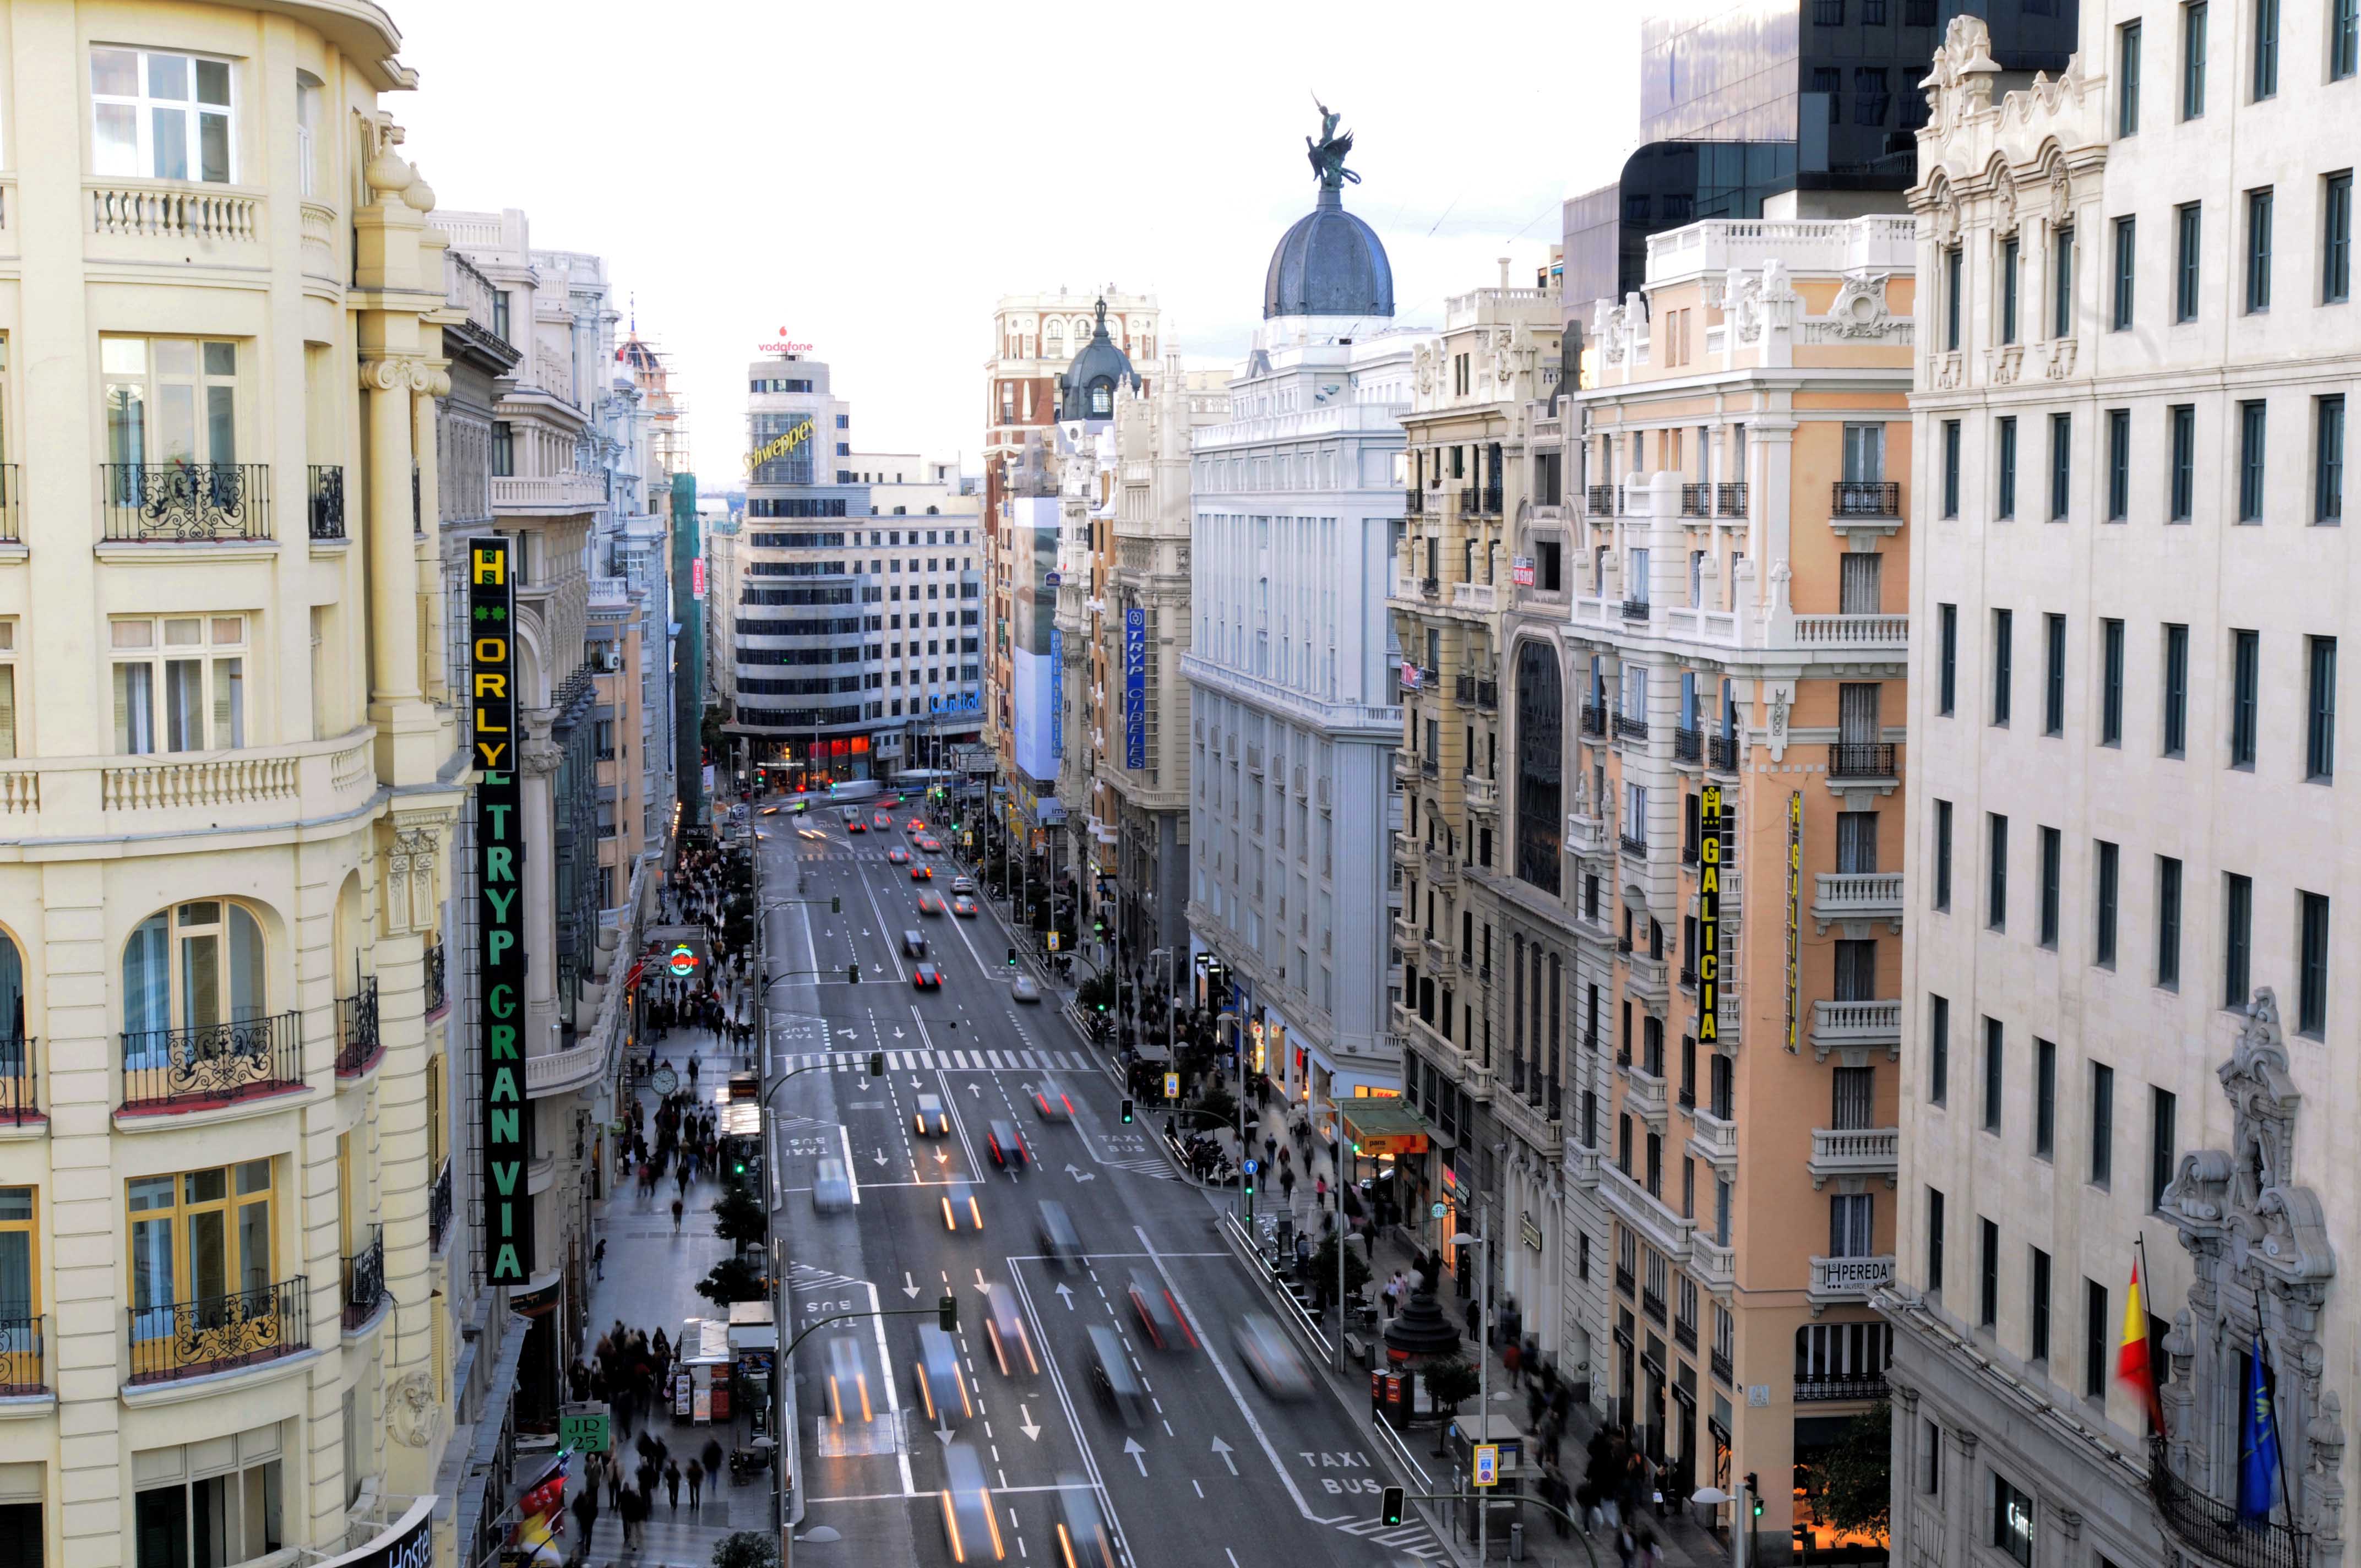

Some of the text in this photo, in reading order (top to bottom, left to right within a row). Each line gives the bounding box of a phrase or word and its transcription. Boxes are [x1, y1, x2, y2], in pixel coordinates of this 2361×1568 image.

[758, 341, 813, 351] vodafone
[743, 417, 817, 477] Schweppes
[475, 639, 507, 766] ORLY
[931, 690, 980, 714] Capitol
[1128, 630, 1144, 768] TRYP CIBELES
[485, 804, 515, 965] TRYP
[1700, 837, 1719, 1038] GALICIA
[1790, 843, 1799, 1048] GALICIA
[489, 984, 519, 1143] GRAN
[786, 1147, 828, 1156] TAXI
[790, 1137, 825, 1146] BUS
[491, 1162, 522, 1278] VIA
[1842, 1263, 1888, 1280] PEREDA
[806, 1300, 851, 1312] BUS
[569, 1419, 600, 1434] JR
[572, 1435, 599, 1450] 25
[1299, 1452, 1371, 1467] TAXI
[1321, 1479, 1382, 1494] BUS
[2008, 1502, 2032, 1540] Cám
[389, 1529, 431, 1568] Hostel
